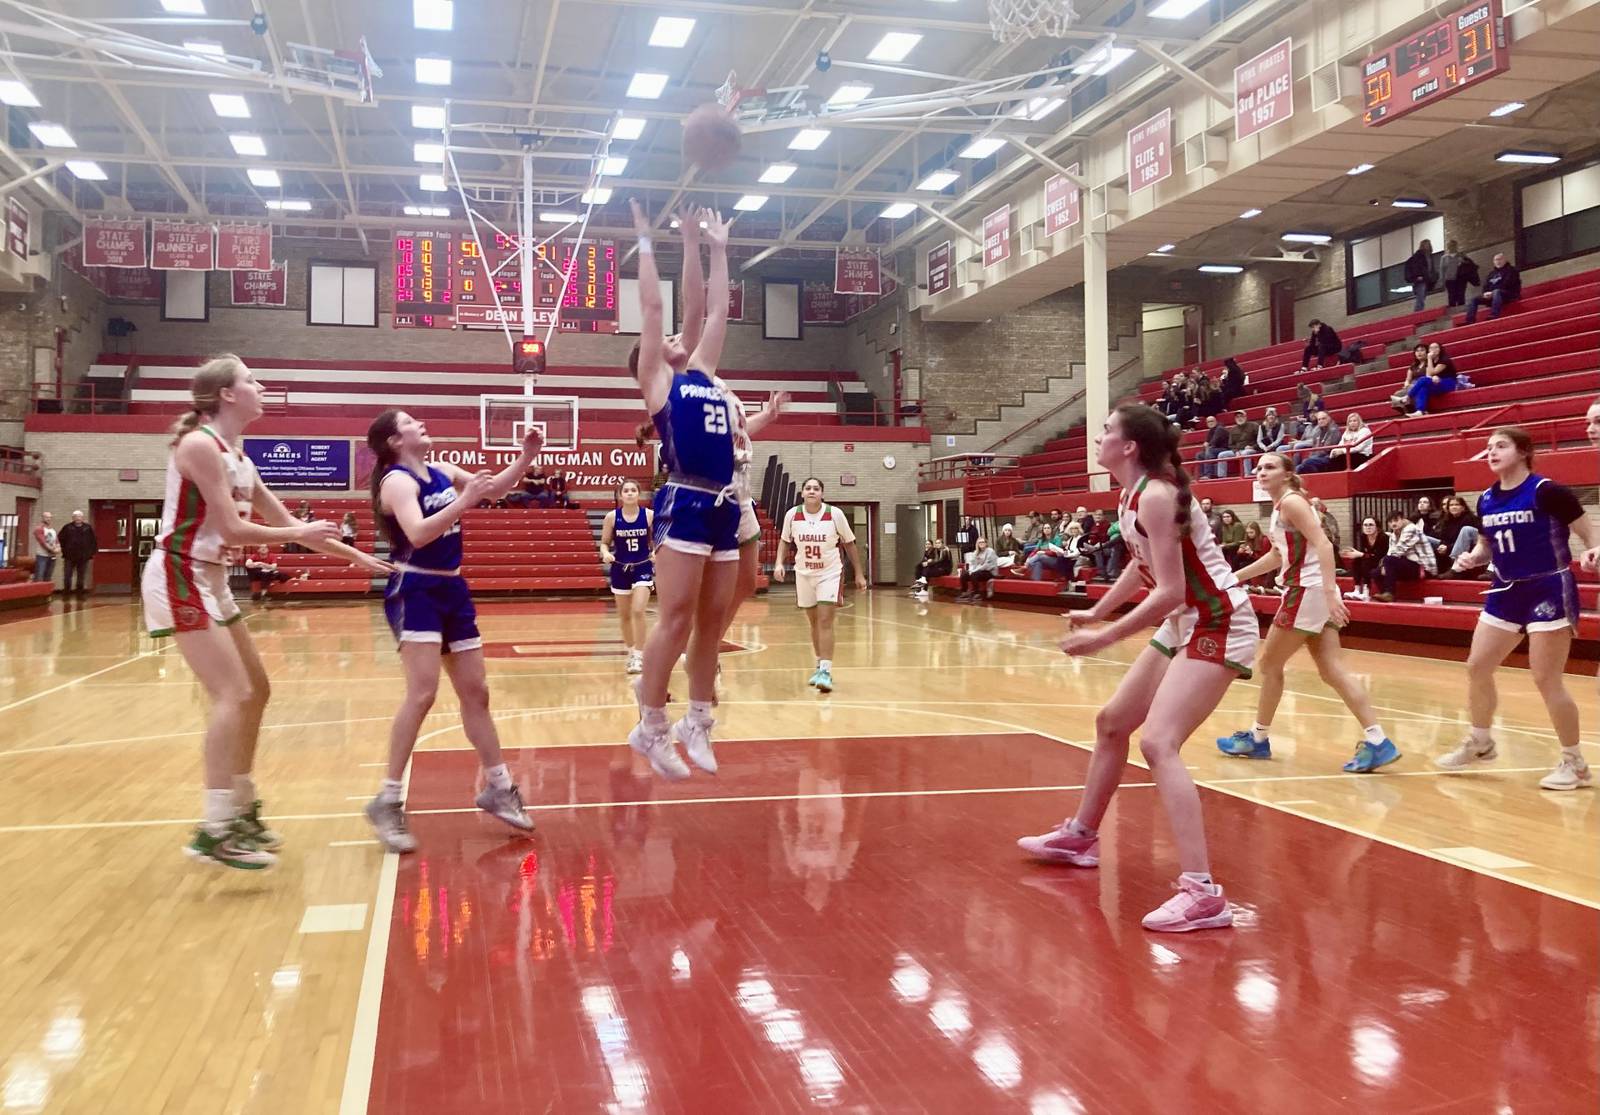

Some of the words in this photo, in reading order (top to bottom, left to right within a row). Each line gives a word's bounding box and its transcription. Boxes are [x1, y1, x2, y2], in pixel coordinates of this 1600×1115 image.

[1458, 6, 1488, 30] Guests
[1463, 23, 1491, 62] 31
[1366, 58, 1387, 76] Home
[1412, 78, 1438, 101] period
[1446, 64, 1457, 83] 4
[1239, 92, 1254, 114] 3rd
[1257, 74, 1289, 105] PLACE
[1368, 71, 1392, 107] 50
[1252, 101, 1275, 126] 1957
[1135, 146, 1155, 169] ELITE
[99, 231, 130, 241] STATE
[168, 233, 197, 243] STATE
[96, 240, 135, 251] CHAMPS
[157, 242, 193, 253] RUNNER
[196, 243, 208, 253] UP
[232, 245, 260, 255] PLACE
[588, 247, 596, 259] 3
[606, 247, 614, 259] 2
[423, 265, 432, 277] 5
[588, 259, 596, 271] 5
[847, 261, 868, 270] STATE
[248, 272, 272, 281] STATE
[588, 272, 596, 283] 3
[606, 271, 614, 283] 0
[844, 270, 873, 279] CHAMPS
[244, 281, 277, 291] CHAMPS
[464, 279, 473, 291] 0
[606, 285, 614, 296] 2
[423, 290, 432, 302] 9
[443, 291, 451, 303] 2
[606, 297, 614, 309] 2
[485, 310, 518, 322] DEAN
[703, 403, 728, 435] 23
[423, 450, 487, 465] ELCOME
[530, 451, 602, 466] INGMAN
[609, 448, 647, 466] GYM
[564, 470, 625, 486] Pirates
[616, 529, 648, 537] PRINCETON
[799, 534, 827, 543] LASALLE
[626, 538, 639, 552] 15
[1494, 529, 1516, 553] 11
[805, 545, 821, 559] 24
[805, 561, 825, 570] PERU
